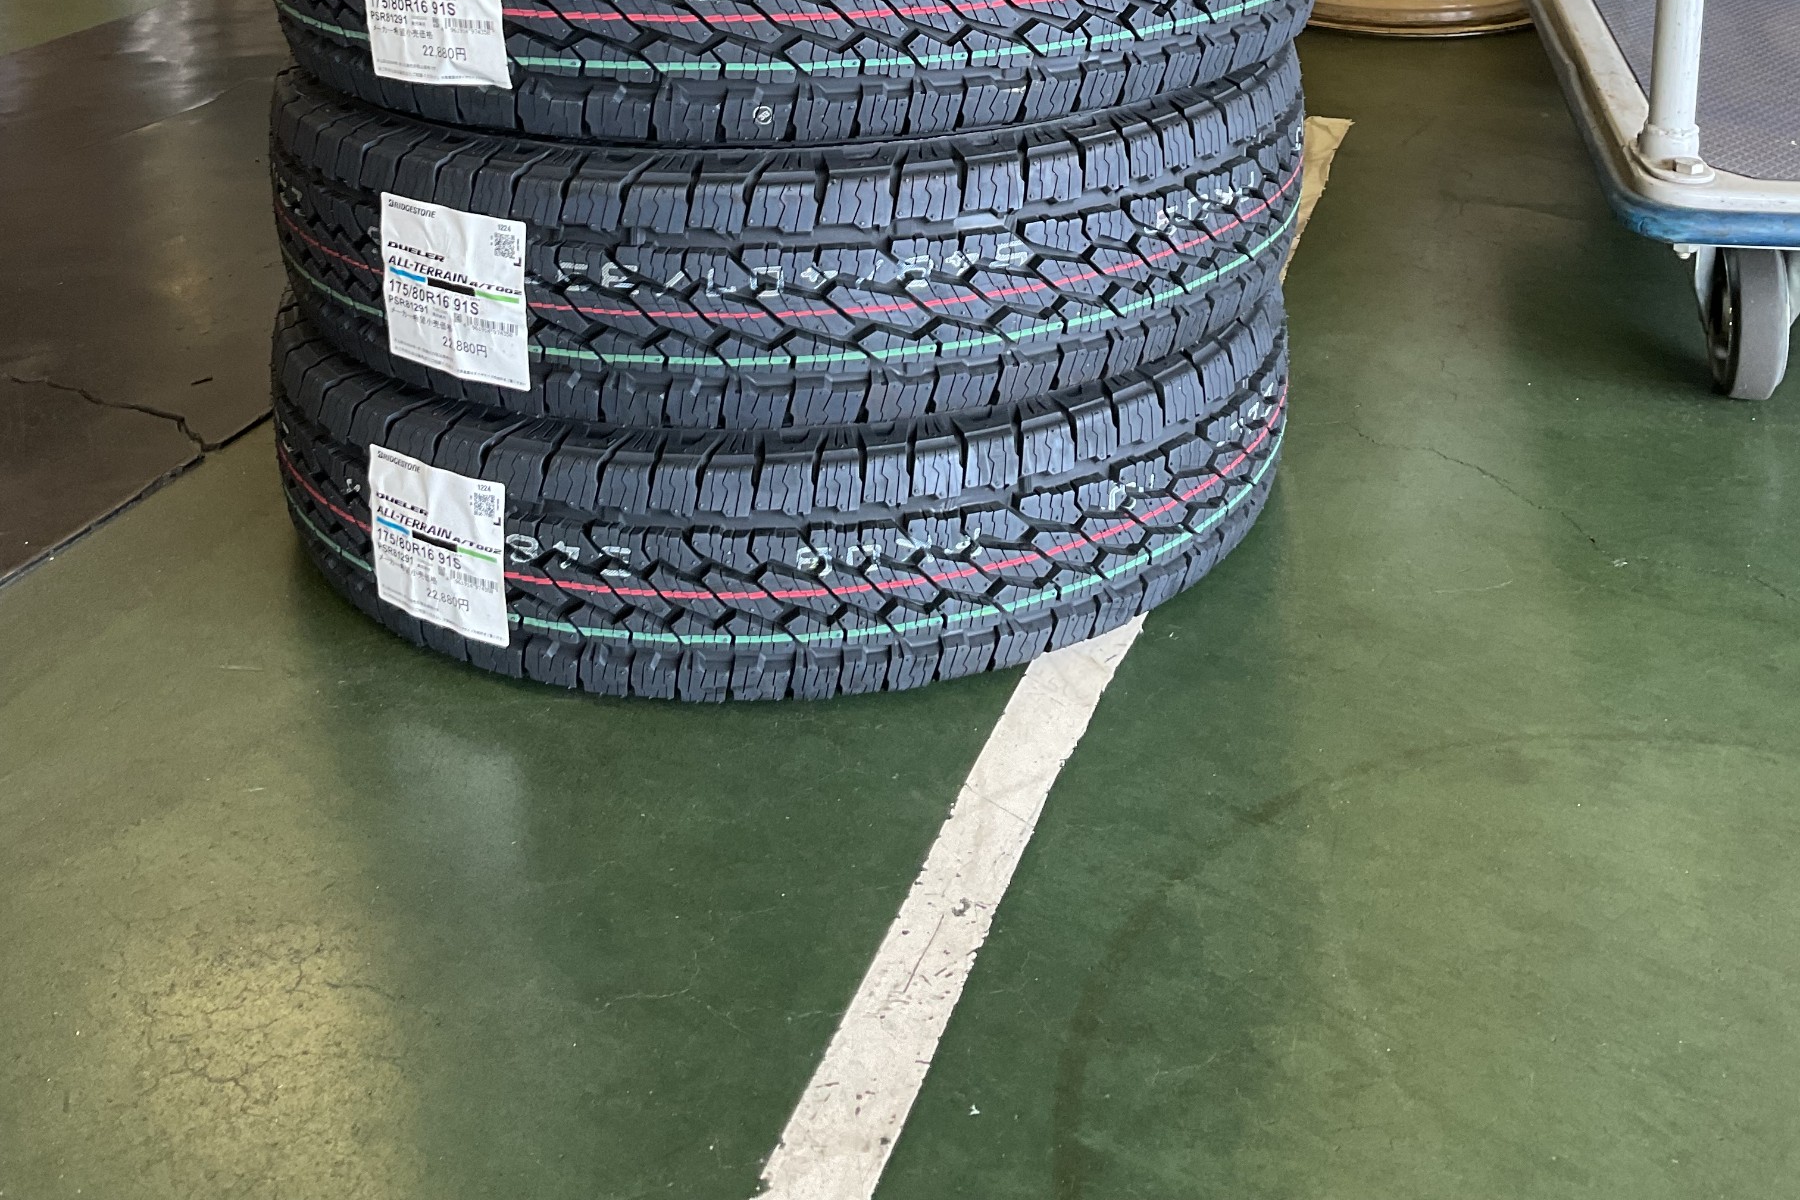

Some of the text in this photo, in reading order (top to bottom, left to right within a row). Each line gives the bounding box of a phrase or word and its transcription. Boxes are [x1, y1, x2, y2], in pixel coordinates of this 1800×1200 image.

[432, 1, 457, 16] 91S
[388, 198, 437, 219] BRIDGESTONE
[497, 223, 512, 232] 1224
[387, 241, 446, 263] DUELER
[388, 254, 523, 297] ALL-TERRAIN A/T002
[388, 278, 480, 316] 175/80R16 91S
[441, 334, 488, 359] 22880円
[377, 450, 421, 474] BRIDGESTONE
[477, 483, 492, 492] 1224
[375, 491, 429, 517] DUELER
[376, 505, 503, 555] ALL-TERRAIN A/T002
[377, 527, 462, 571] 175/80R16 91S
